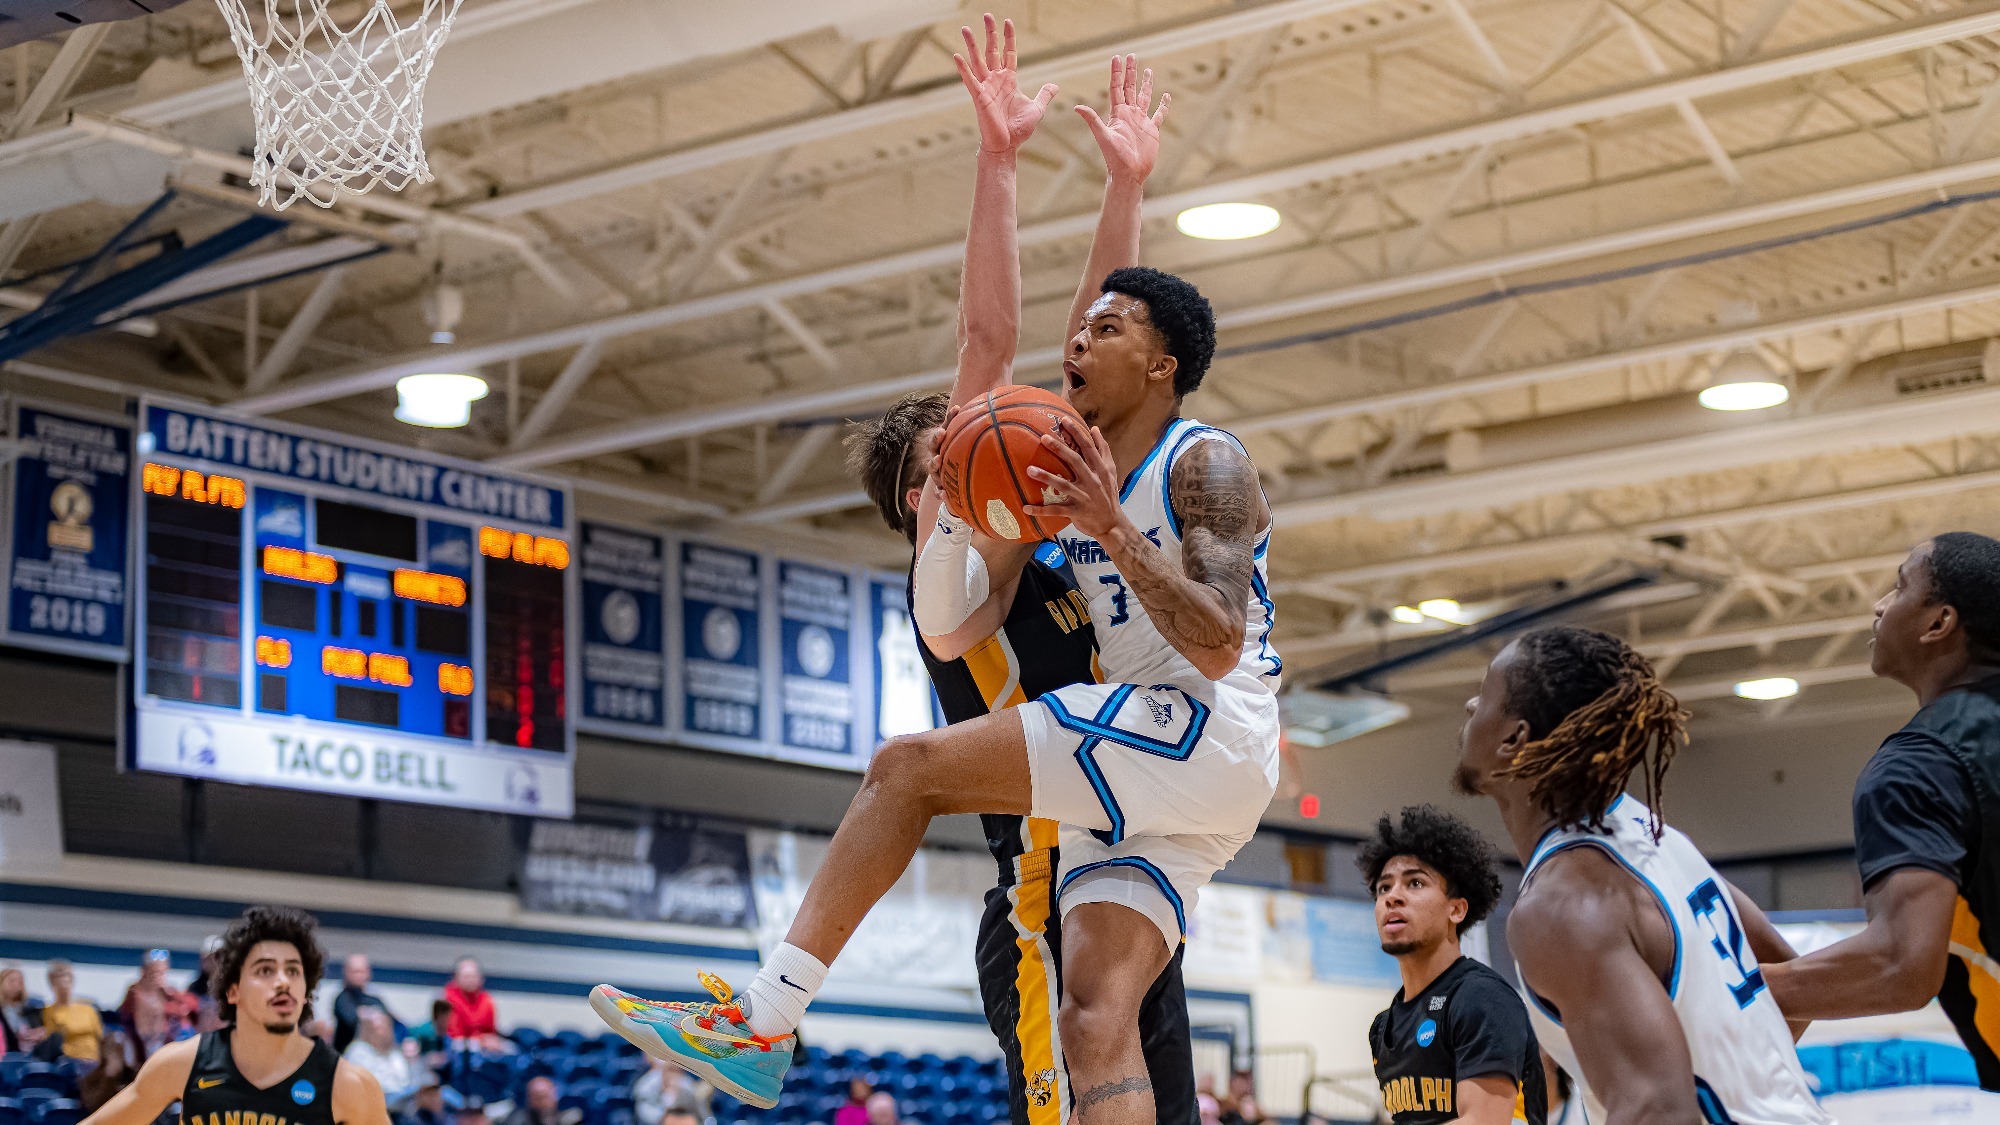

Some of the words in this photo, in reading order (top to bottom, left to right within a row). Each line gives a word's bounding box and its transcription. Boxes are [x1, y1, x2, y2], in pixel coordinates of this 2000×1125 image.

[166, 412, 291, 473] BATTEN
[297, 439, 436, 501] STUDENT
[440, 469, 553, 523] CENTER
[1043, 546, 1063, 567] NCAA
[30, 595, 106, 637] 2019
[1098, 573, 1130, 628] 3
[271, 734, 363, 781] TACO
[373, 750, 455, 792] BELL
[1382, 1076, 1452, 1114] NDOLPH
